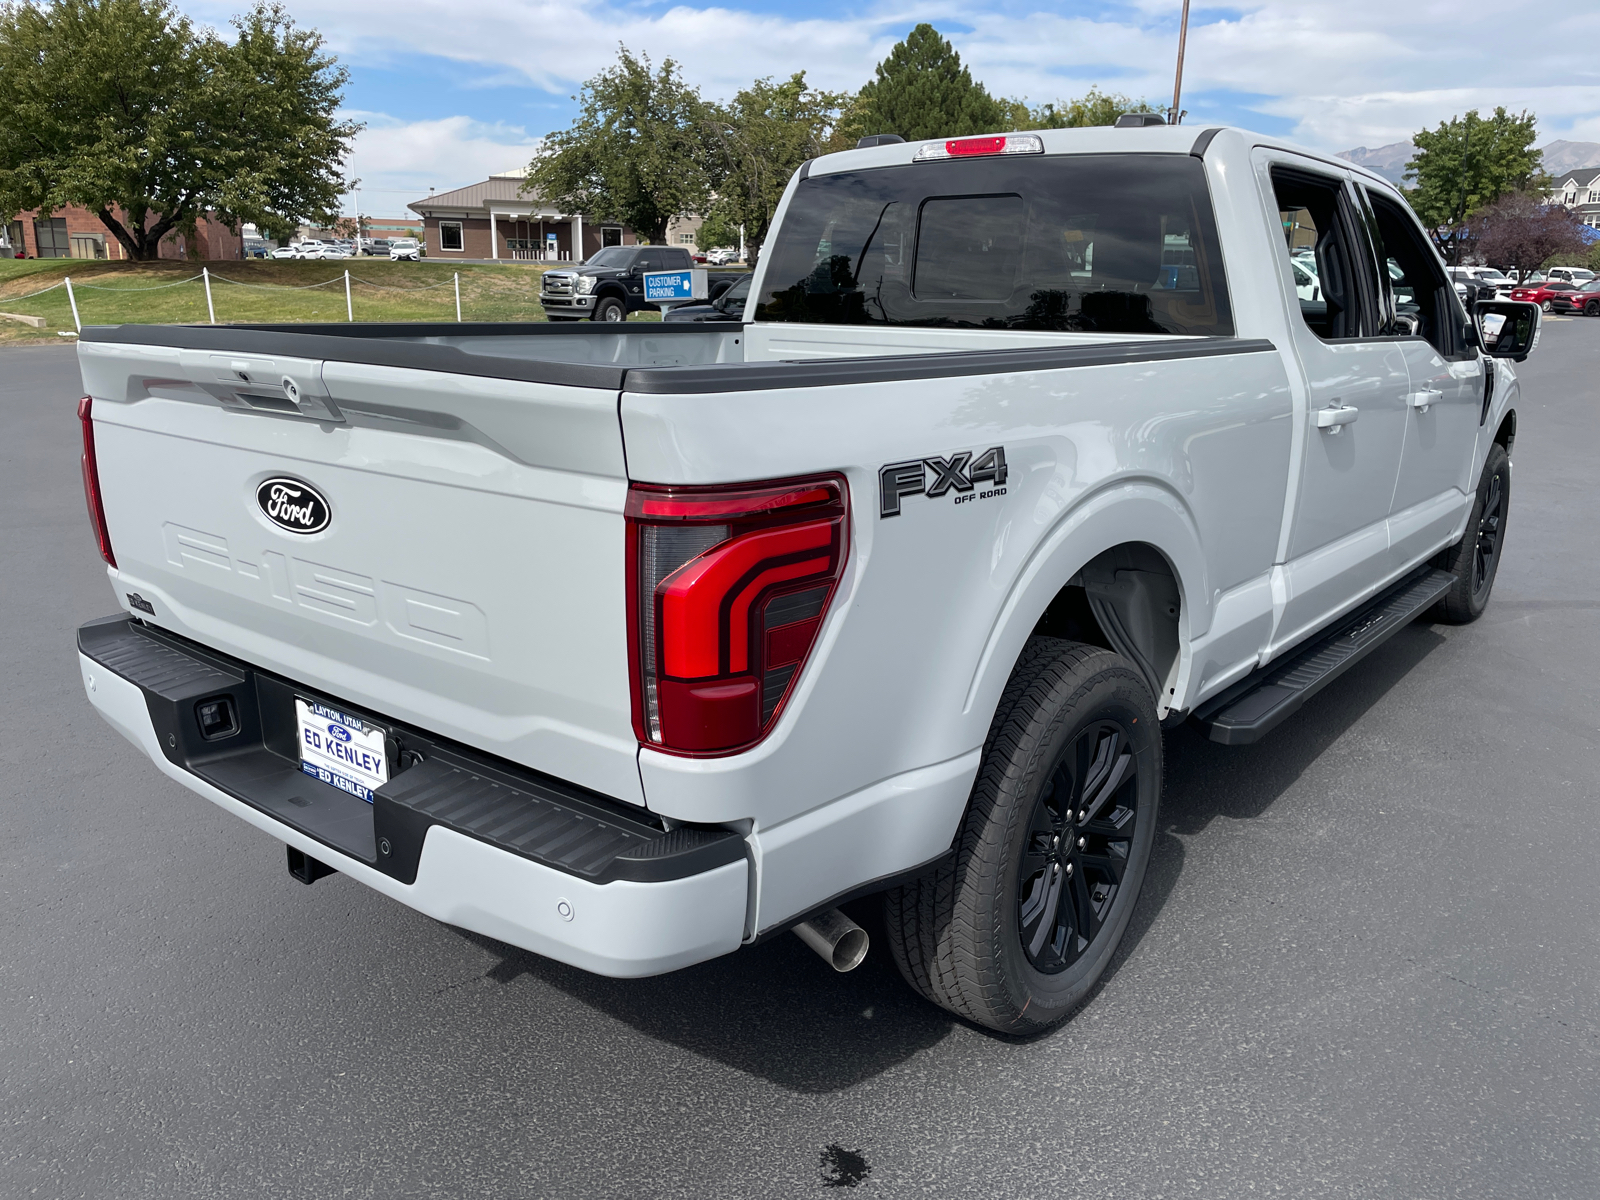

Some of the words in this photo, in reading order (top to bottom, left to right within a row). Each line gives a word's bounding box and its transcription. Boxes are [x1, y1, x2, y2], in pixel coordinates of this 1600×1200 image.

[648, 276, 681, 287] CUSTOMER
[649, 287, 675, 297] PARKING
[878, 445, 1008, 520] FX4
[954, 494, 976, 504] OFF
[979, 487, 1007, 499] ROAD
[267, 484, 314, 526] Ford
[162, 520, 492, 662] F-150
[314, 703, 342, 723] LAYTON,
[343, 715, 362, 731] UTAH
[331, 726, 347, 741] Ford
[304, 727, 321, 749] ED
[325, 737, 381, 774] KENLEY
[333, 774, 368, 800] KENLEY
